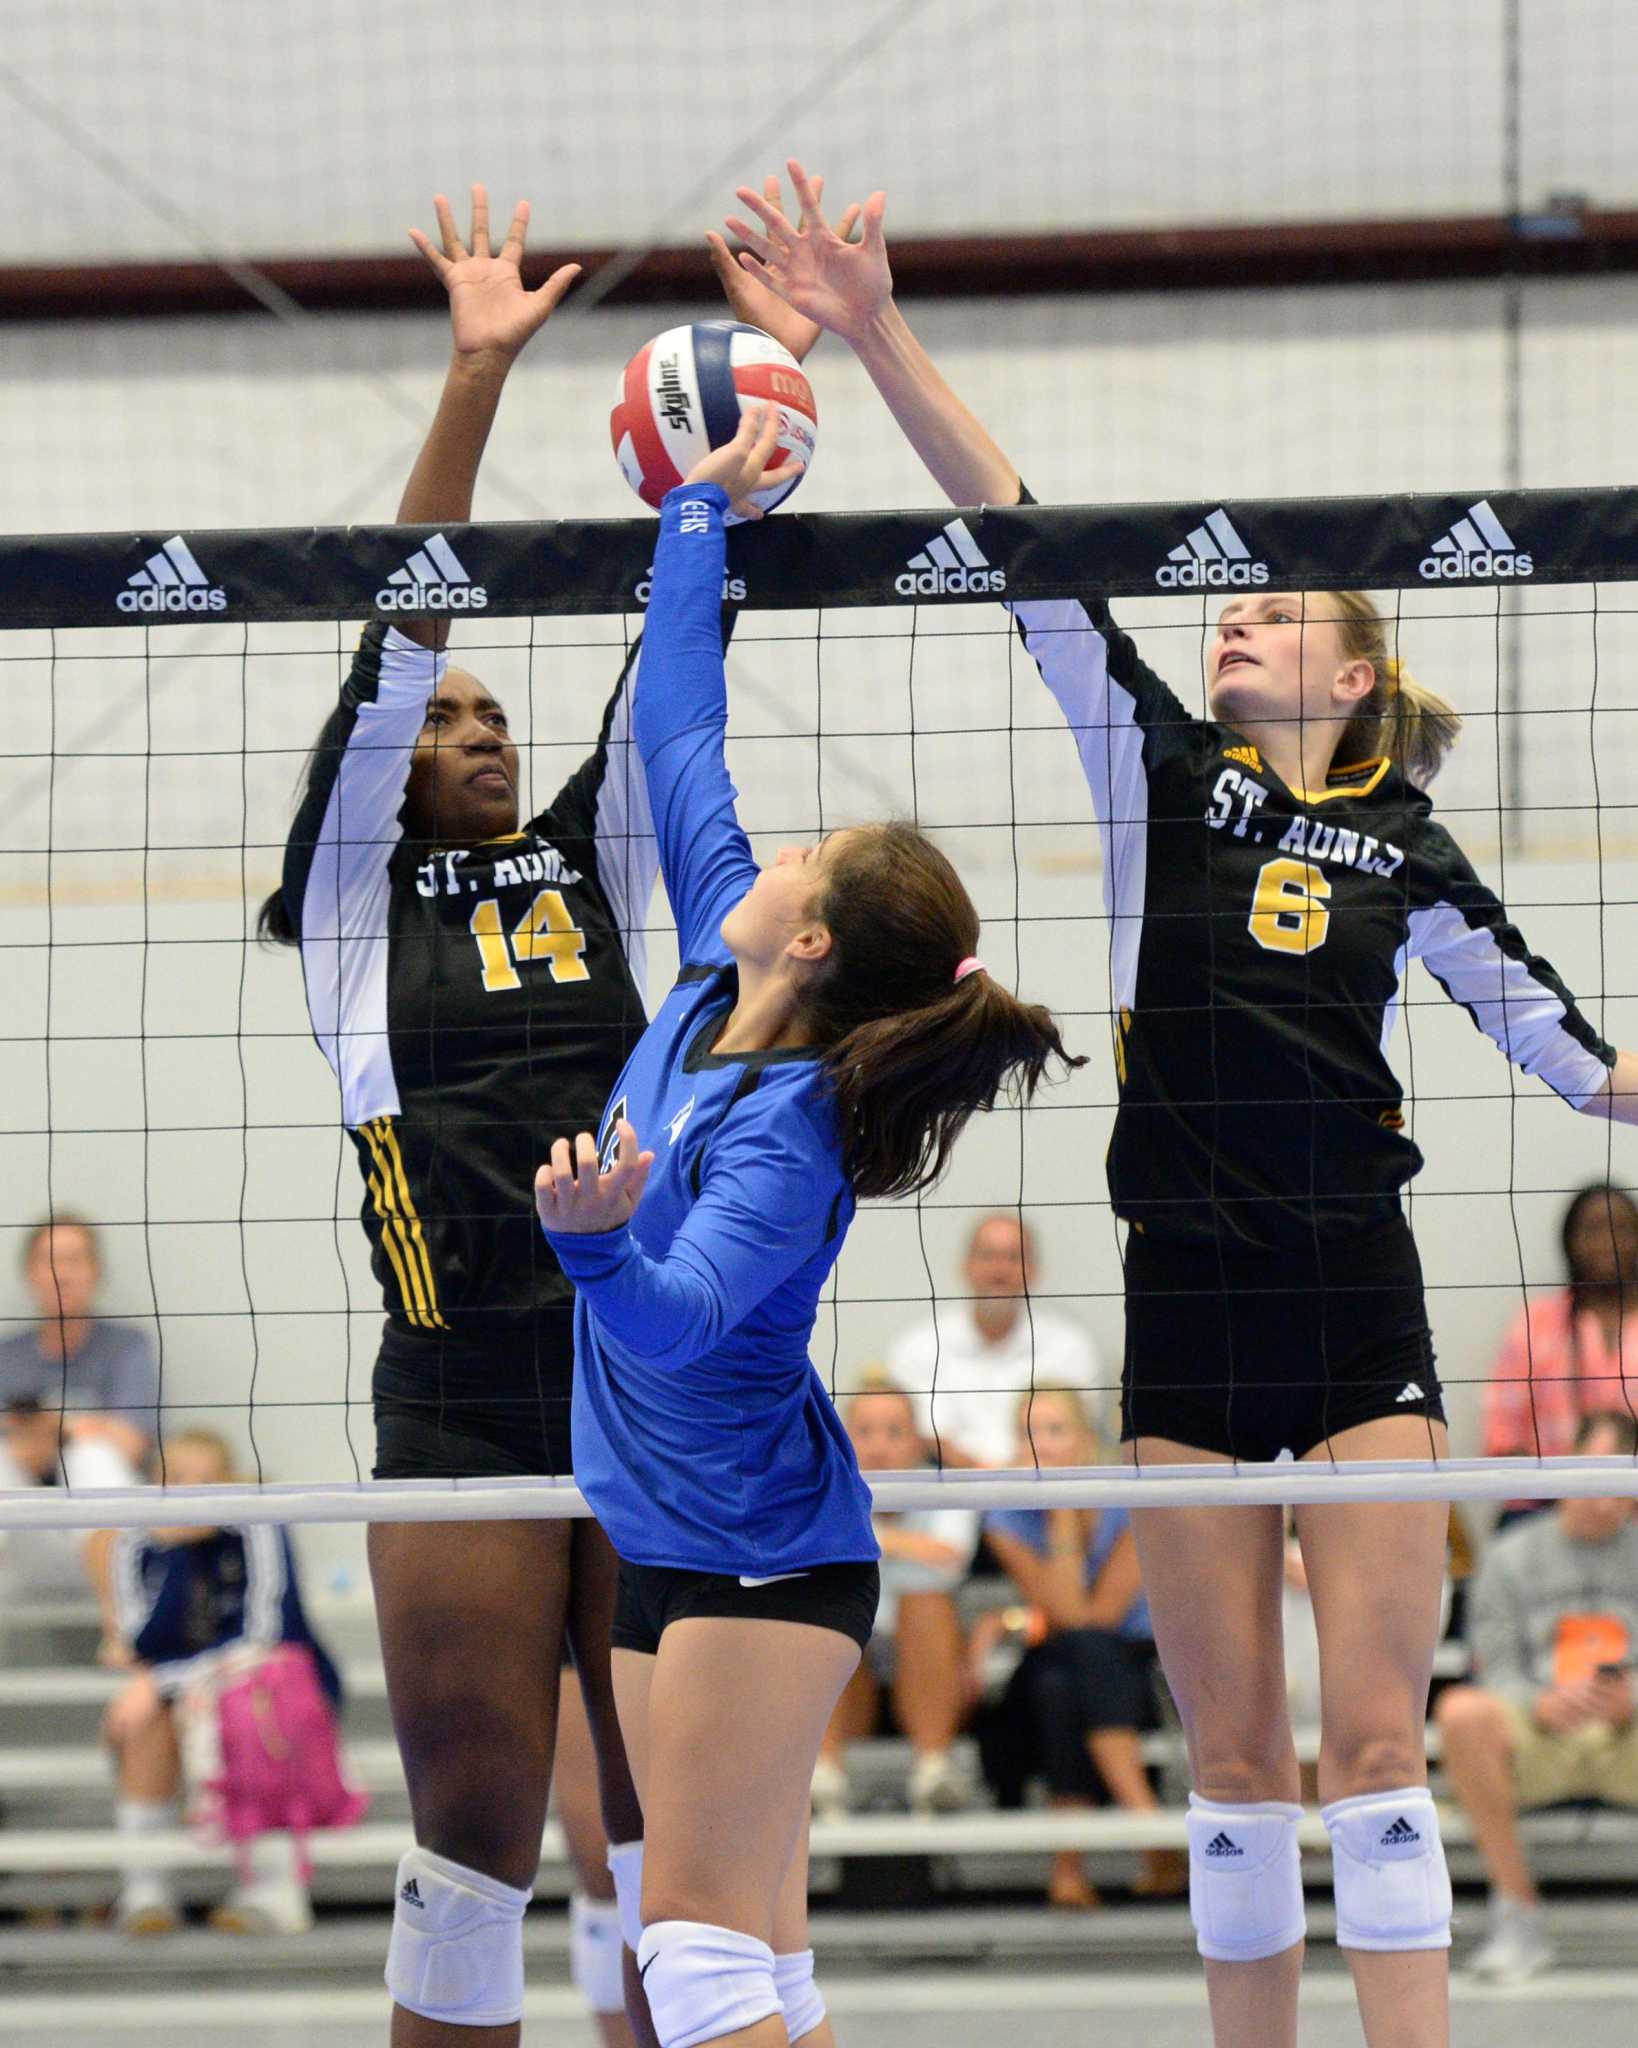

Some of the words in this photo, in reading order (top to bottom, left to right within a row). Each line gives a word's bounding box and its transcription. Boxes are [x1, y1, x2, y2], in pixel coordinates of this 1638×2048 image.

[679, 500, 709, 533] EHS
[1155, 557, 1270, 588] adidas
[1418, 549, 1534, 580] adidas
[375, 582, 488, 610] adidas
[894, 566, 1007, 595] adidas
[116, 583, 227, 612] adidas
[1204, 768, 1269, 843] ST.
[1248, 857, 1332, 956] 6
[469, 889, 591, 992] 14
